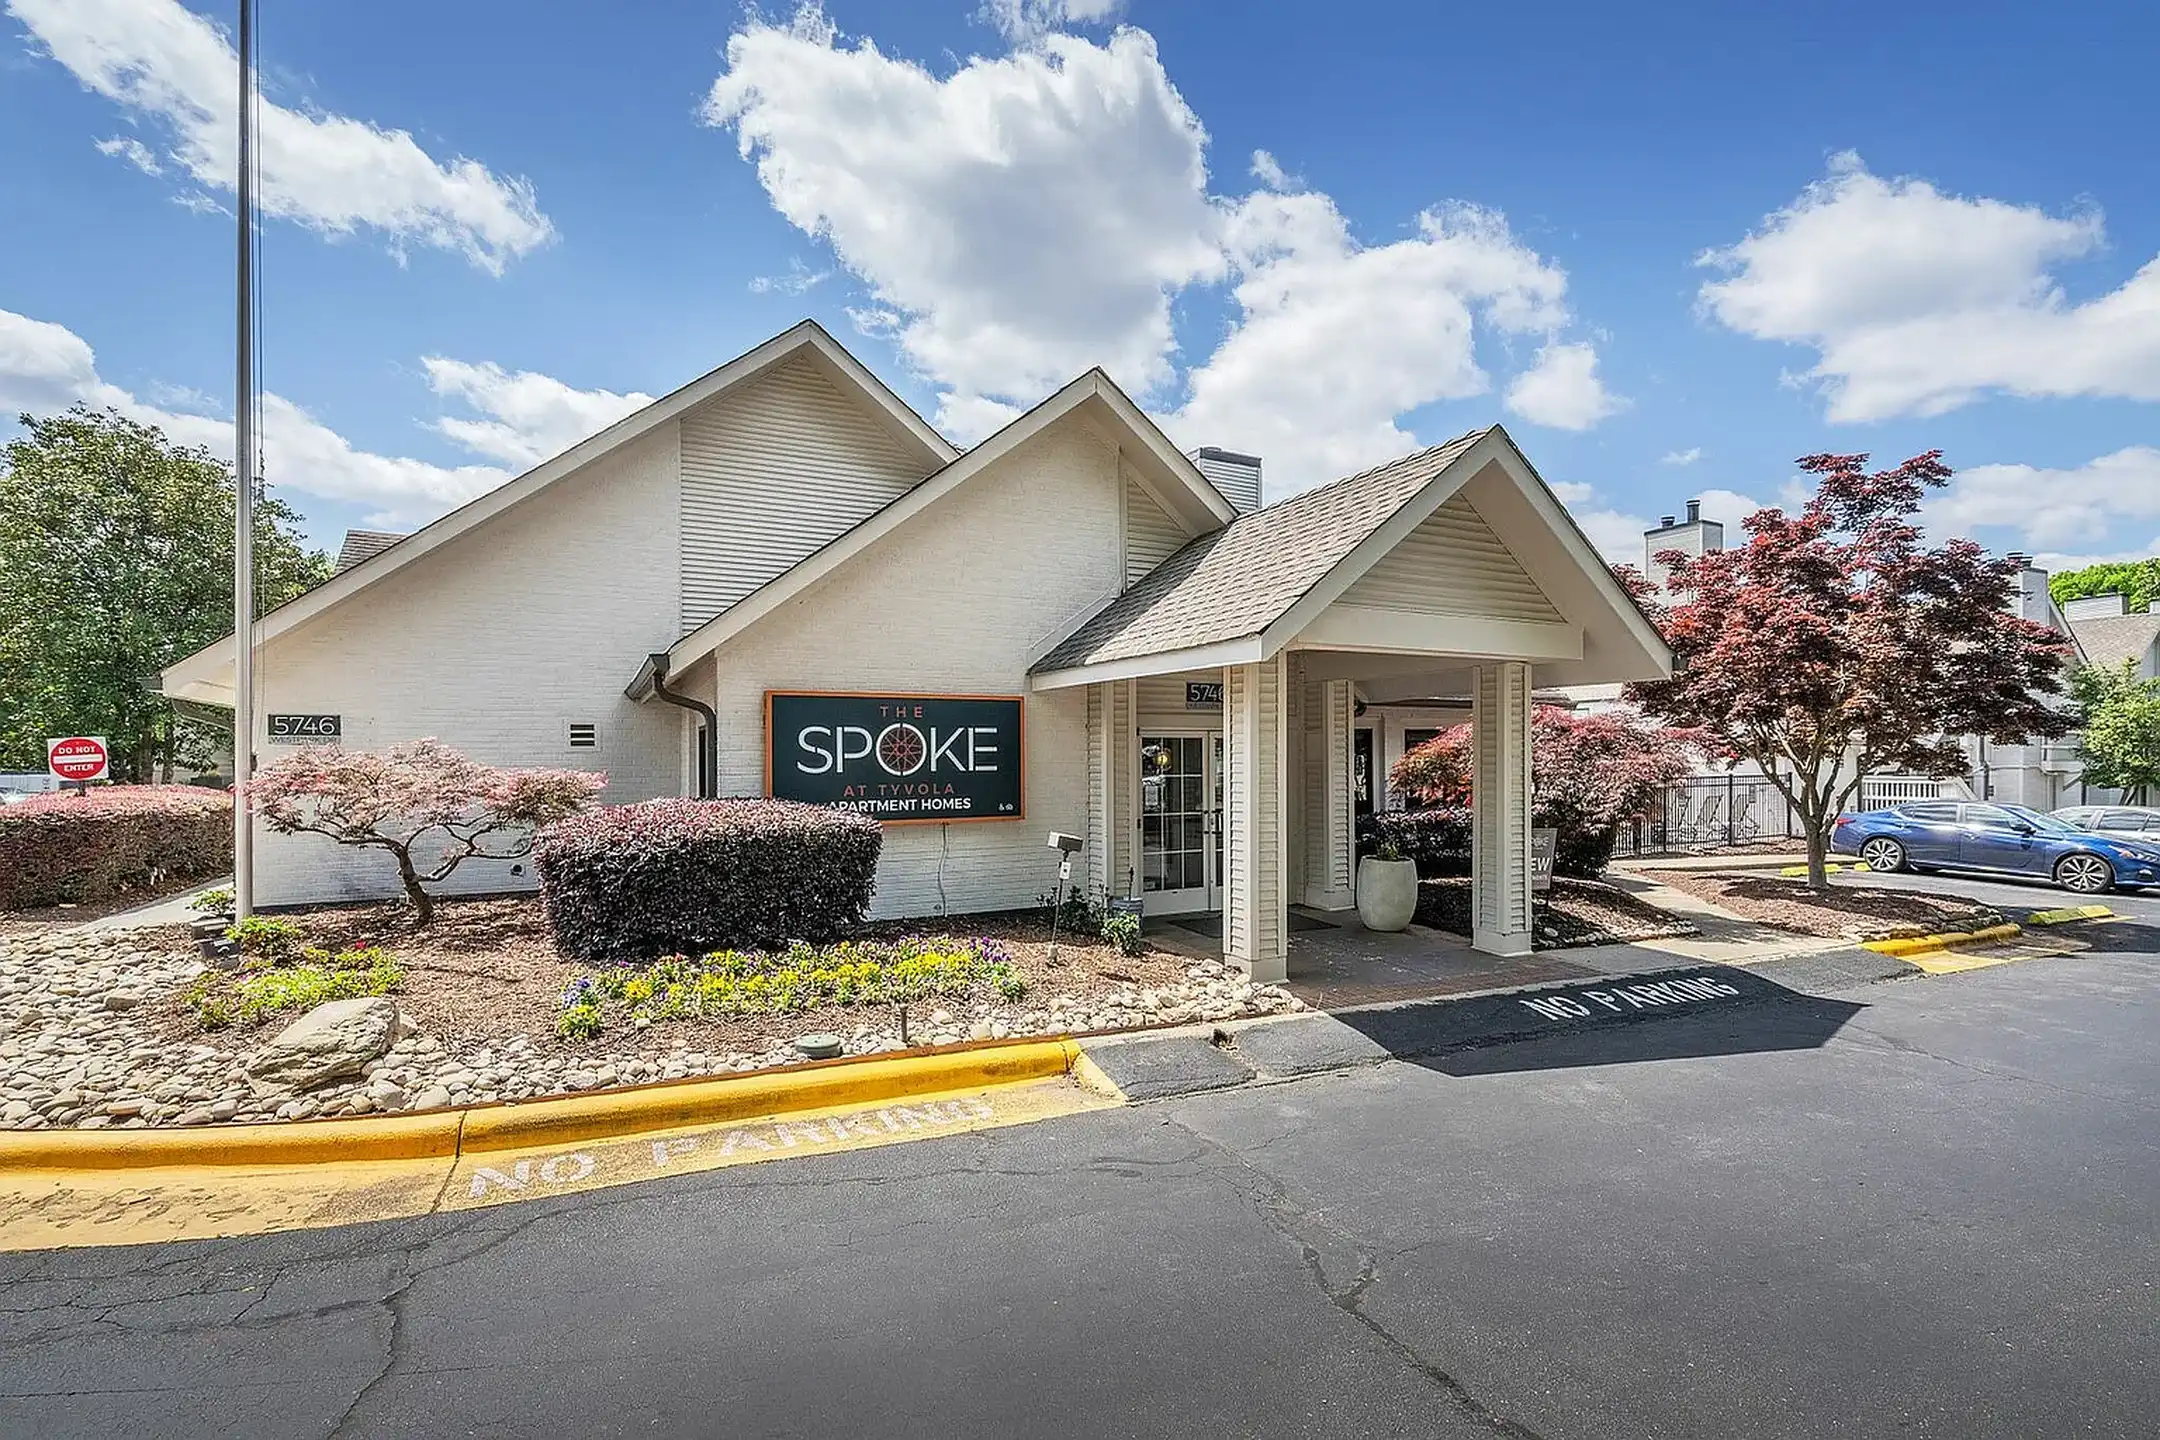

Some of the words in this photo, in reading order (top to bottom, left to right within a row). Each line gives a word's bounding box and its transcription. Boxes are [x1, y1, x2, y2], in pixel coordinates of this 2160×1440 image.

[879, 705, 924, 718] THE
[274, 717, 335, 734] 5746
[58, 747, 73, 755] DO
[76, 746, 96, 754] NOT
[796, 723, 998, 776] SPOKE
[63, 763, 94, 772] ENTER
[843, 784, 867, 797] AT
[878, 783, 955, 796] TYVOLA
[921, 797, 972, 811] HOMES
[1531, 857, 1550, 871] EW
[1517, 996, 1592, 1021] NO
[1580, 976, 1740, 1013] PARKING
[468, 1153, 595, 1199] NO
[651, 1098, 996, 1168] PARKING
